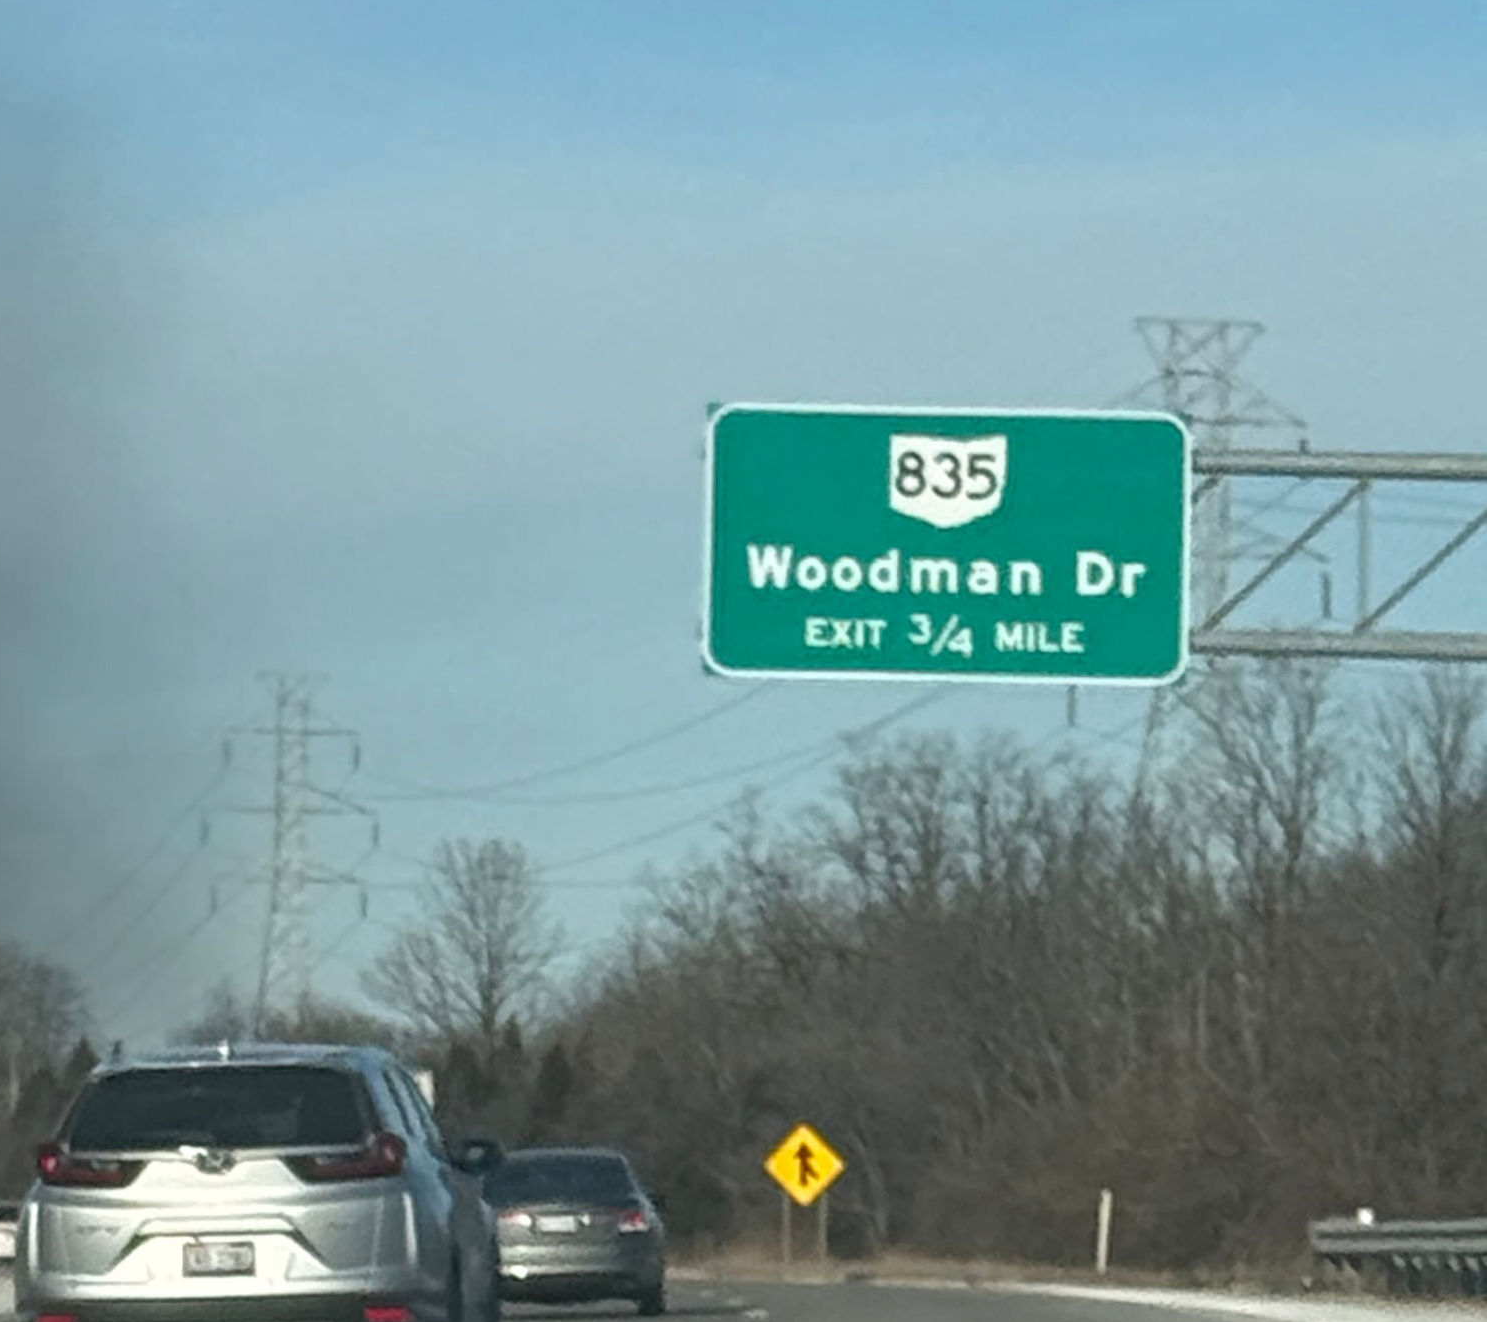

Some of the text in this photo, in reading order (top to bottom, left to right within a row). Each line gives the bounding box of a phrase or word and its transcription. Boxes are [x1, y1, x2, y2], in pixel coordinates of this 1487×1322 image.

[895, 450, 998, 500] 835
[746, 544, 1147, 599] Woodman Dr
[803, 617, 887, 650] EXIT
[994, 621, 1086, 653] MILE
